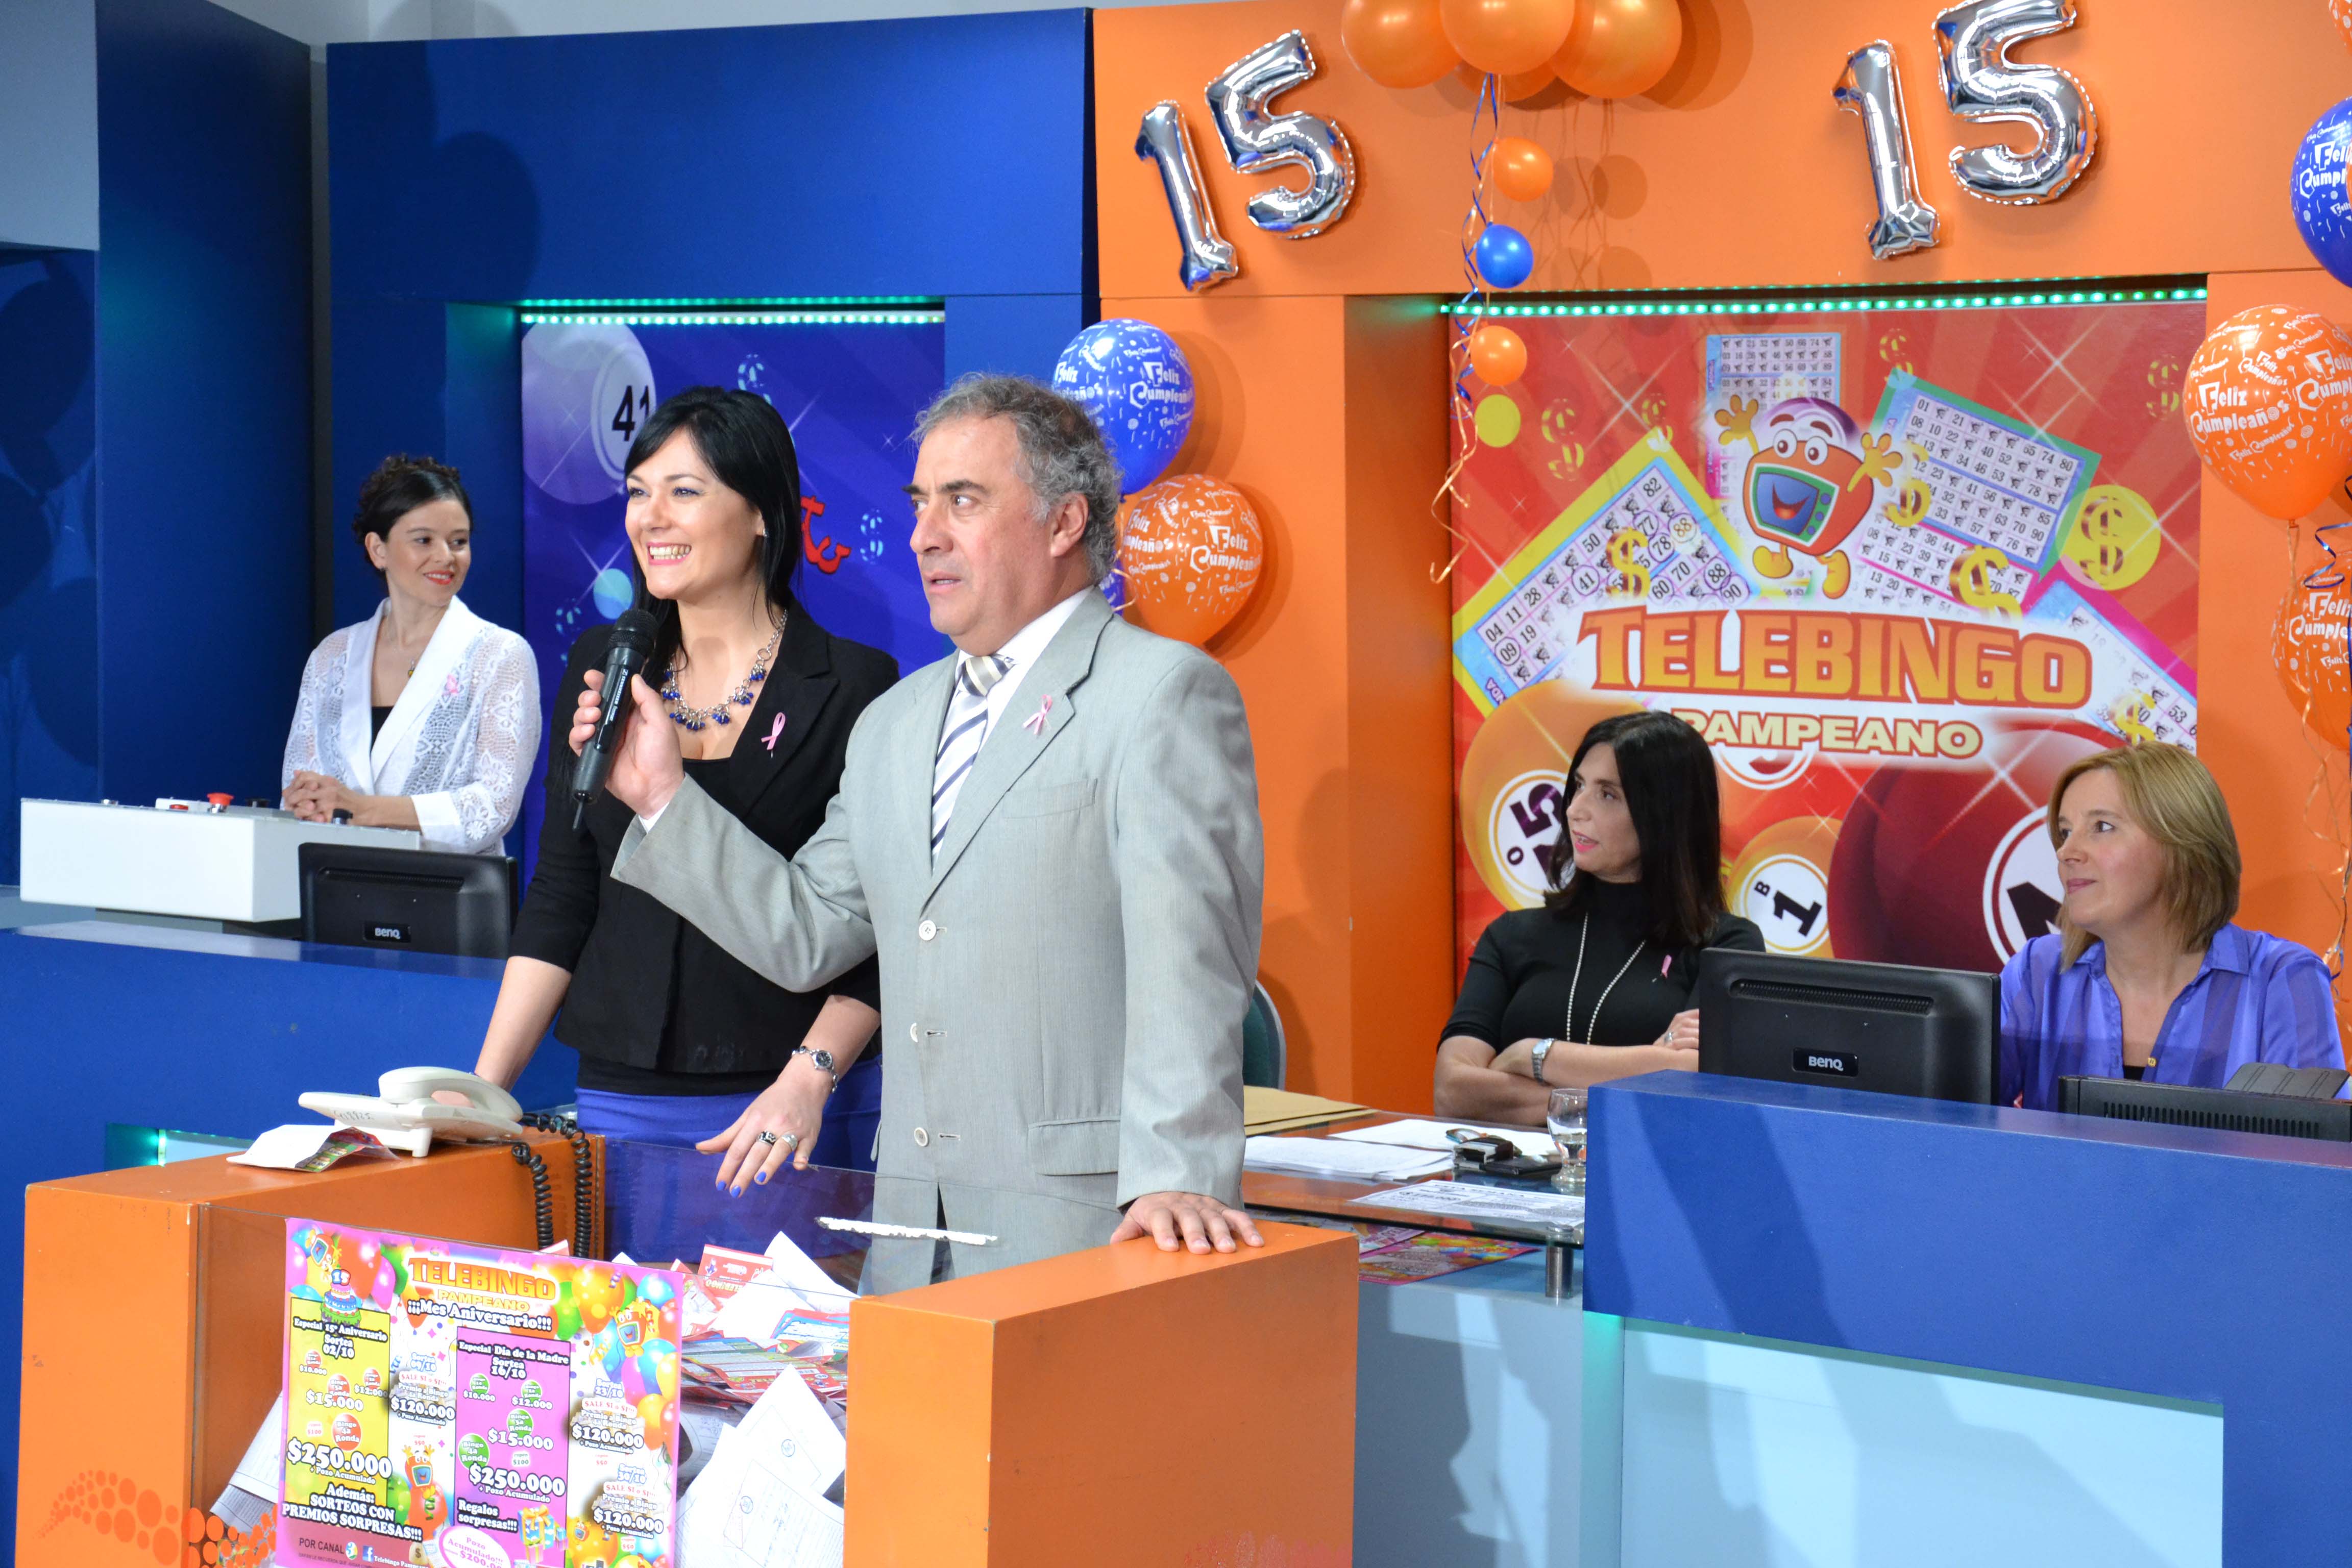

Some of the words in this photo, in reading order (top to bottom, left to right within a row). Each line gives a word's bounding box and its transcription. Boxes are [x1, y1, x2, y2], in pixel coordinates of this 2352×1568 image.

[1830, 0, 2097, 260] 15
[1135, 29, 1356, 292] 15
[2314, 141, 2352, 171] Feli
[1143, 361, 1180, 387] Feliz
[2198, 381, 2247, 415] Feliz
[2190, 400, 2290, 444] Cumpleaños
[1911, 415, 1924, 429] 08
[1928, 423, 1941, 436] 10
[1945, 430, 1959, 443] 22
[1981, 445, 1995, 458] 40
[1998, 452, 2012, 465] 52
[1918, 399, 1929, 412] 01
[1952, 413, 1965, 427] 21
[2042, 451, 2055, 464] 74
[2060, 458, 2073, 472] 80
[1956, 454, 1970, 468] 34
[1974, 461, 1988, 475] 46
[1991, 469, 2005, 482] 53
[2027, 483, 2042, 497] 78
[1930, 467, 1944, 480] 23
[1966, 482, 1979, 495] 41
[1983, 489, 1997, 503] 56
[2037, 511, 2051, 526] 85
[1941, 490, 1955, 504] 32
[1994, 513, 2008, 527] 63
[2013, 520, 2027, 534] 70
[2030, 528, 2045, 542] 90
[1209, 525, 1248, 553] Feliz
[1652, 535, 1672, 556] 78
[1673, 518, 1692, 538] 88
[1867, 526, 1880, 540] 08
[1900, 541, 1914, 555] 23
[1918, 549, 1932, 563] 39
[1923, 533, 1938, 547] 36
[1942, 541, 1956, 555] 44
[1970, 522, 1984, 535] 57
[2005, 536, 2020, 551] 76
[1486, 623, 1504, 643] 04
[1505, 605, 1523, 624] 11
[1524, 587, 1542, 607] 28
[1583, 532, 1601, 553] 50
[1643, 477, 1662, 498] 82
[1877, 550, 1891, 562] 15
[1652, 579, 1670, 600] 60
[1671, 561, 1691, 582] 70
[1707, 562, 1727, 584] 88
[1870, 571, 1883, 584] 13
[1886, 577, 1900, 592] 20
[1500, 642, 1517, 663] 09
[1520, 624, 1536, 644] 19
[1579, 572, 1596, 590] 41
[1637, 515, 1655, 536] 77
[1722, 583, 1743, 604] 90
[1576, 605, 2093, 710] TELEBINGO
[2168, 704, 2188, 724] 53
[1755, 880, 1771, 897] B
[1773, 889, 1823, 937] 1
[332, 1269, 351, 1286] 15
[408, 1257, 556, 1301] TELEBINGO
[437, 1289, 530, 1312] PAMPEANO
[293, 1316, 323, 1331] Especial
[338, 1324, 388, 1342] Aniversario
[448, 1303, 553, 1332] Aniversario!!!
[323, 1344, 355, 1359] 02/10
[324, 1334, 354, 1348] Sortea
[459, 1341, 492, 1354] Especial
[512, 1348, 525, 1359] de
[526, 1350, 536, 1360] la
[537, 1352, 570, 1364] Madre
[491, 1366, 527, 1380] 16/10
[492, 1357, 525, 1369] Sortea
[306, 1389, 364, 1412] $15.000
[354, 1384, 388, 1398] $12.000
[463, 1390, 496, 1403] $10.000
[511, 1395, 554, 1410] $12.000
[390, 1394, 456, 1421] $120.000
[335, 1435, 360, 1443] Ronda
[487, 1428, 554, 1451] $15.000
[571, 1422, 645, 1449] $120.000
[286, 1437, 393, 1479] $250.000
[461, 1454, 487, 1463] Ronda
[315, 1466, 334, 1477] Pozo
[334, 1468, 376, 1485] Acumulado
[469, 1461, 567, 1498] $250.000
[617, 1471, 647, 1485] 30/10
[326, 1483, 375, 1504] Además:
[485, 1485, 505, 1496] Pozo
[505, 1488, 551, 1504] Acumulado
[310, 1493, 367, 1516] SORTEOS
[368, 1505, 396, 1522] CON
[458, 1499, 499, 1516] Regalos
[593, 1506, 665, 1535] $120.000
[282, 1503, 338, 1525] PREMIOS
[339, 1514, 423, 1542] SORPRESAS!!!
[458, 1513, 518, 1532] sorpresas!!!
[299, 1537, 316, 1549] POR
[317, 1540, 345, 1555] CANAL
[466, 1537, 486, 1550] Pozo
